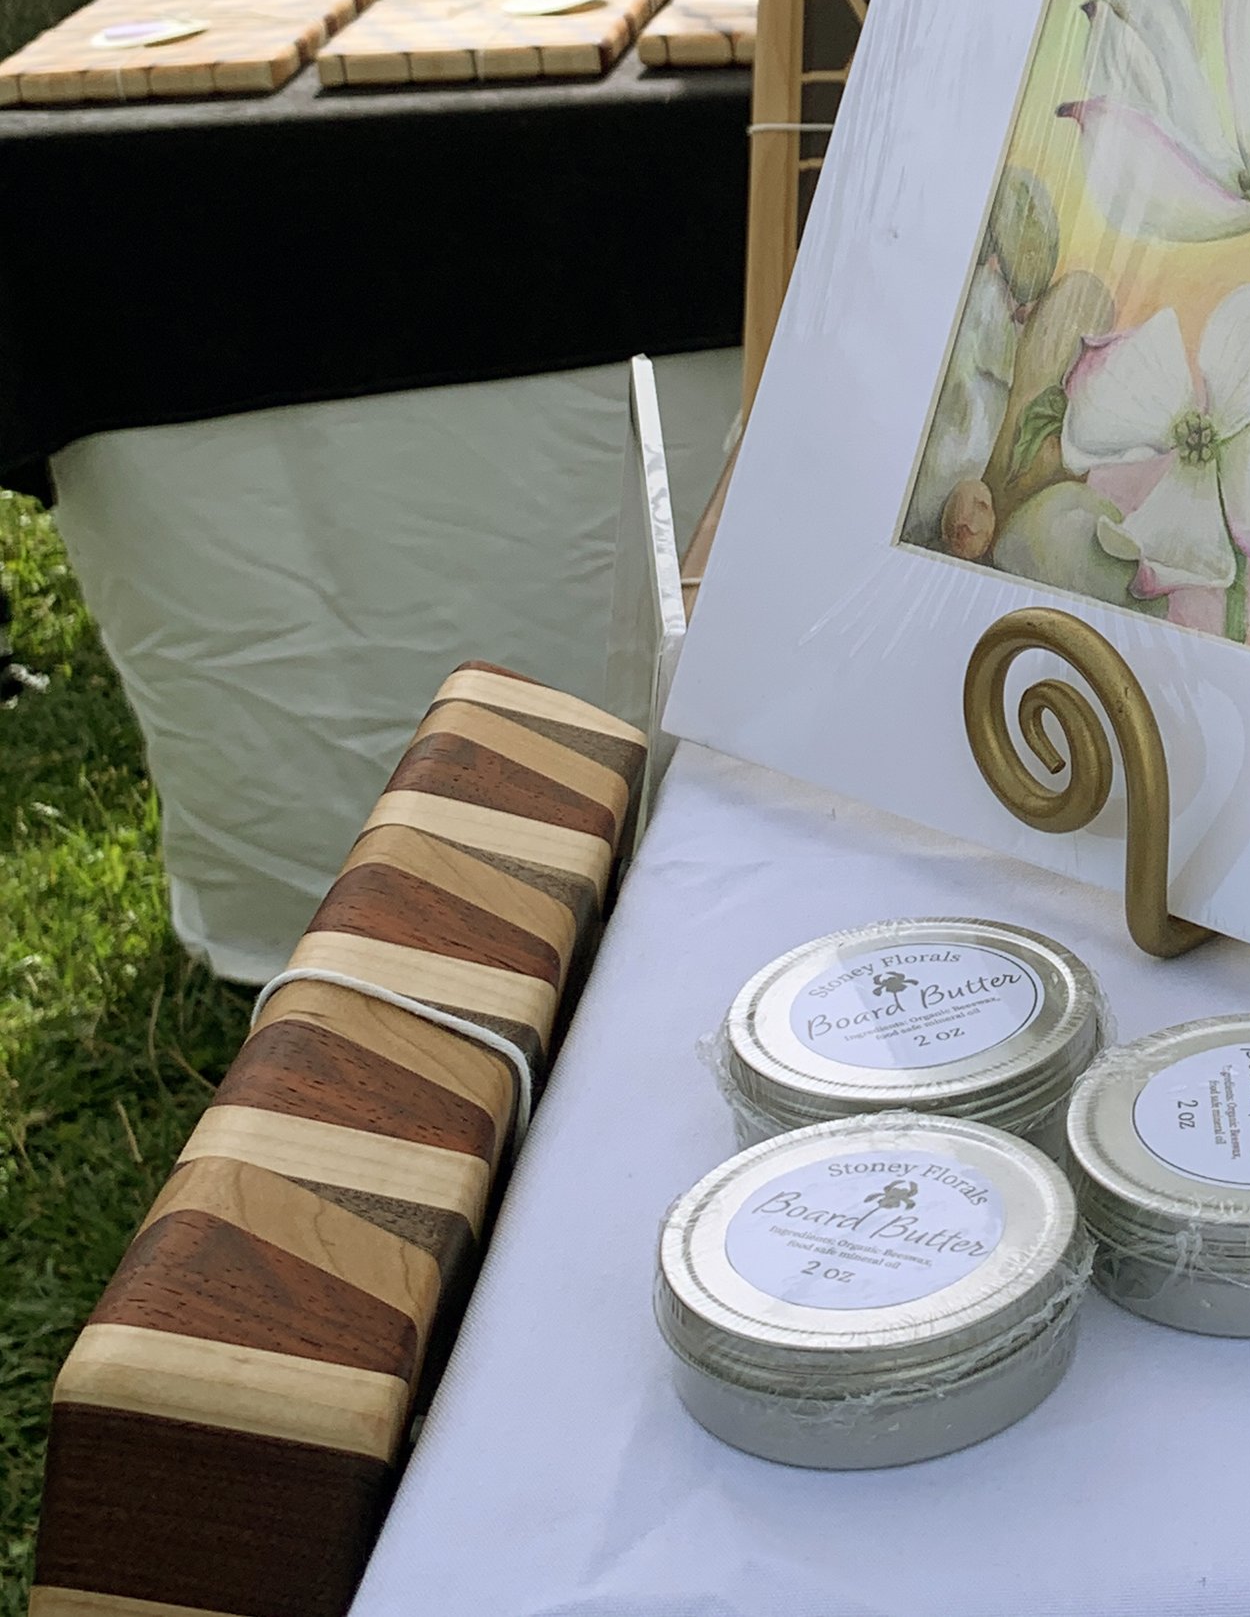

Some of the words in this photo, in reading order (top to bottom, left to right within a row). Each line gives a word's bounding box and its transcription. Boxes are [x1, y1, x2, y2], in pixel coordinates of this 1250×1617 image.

[808, 962, 875, 999] Stoney
[880, 950, 962, 969] Florals
[807, 992, 906, 1041] Board
[920, 972, 1023, 1010] Butter
[913, 1034, 931, 1047] 2
[935, 1027, 966, 1041] oz
[1177, 1099, 1199, 1109] 2
[1178, 1112, 1196, 1130] oz
[827, 1162, 918, 1178] Stoney
[919, 1163, 988, 1207] Florals
[751, 1190, 864, 1232] Board
[869, 1215, 990, 1259] Butter
[801, 1260, 821, 1276] 2
[823, 1268, 857, 1283] oz
